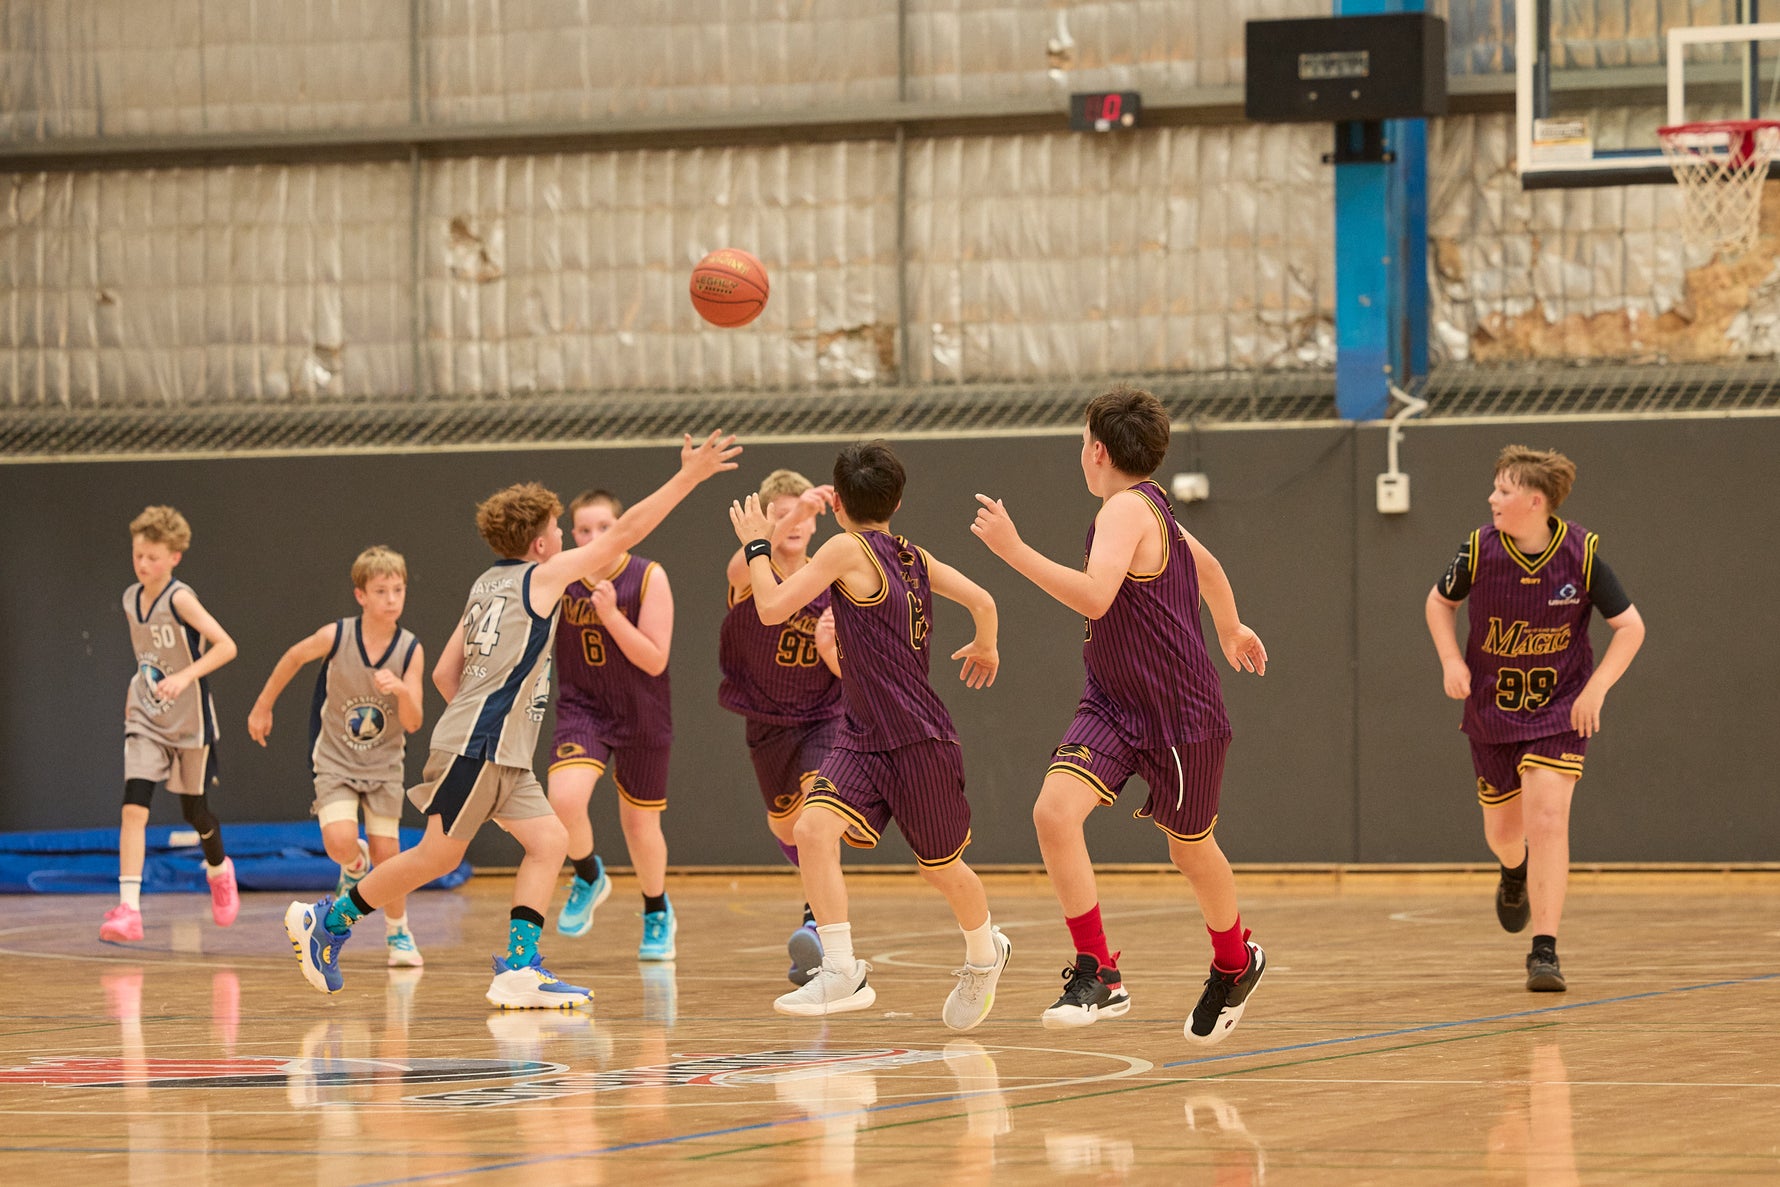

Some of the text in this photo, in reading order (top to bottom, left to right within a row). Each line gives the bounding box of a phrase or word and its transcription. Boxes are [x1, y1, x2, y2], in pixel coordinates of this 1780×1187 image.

[1102, 93, 1122, 121] 0
[150, 624, 176, 648] 50
[582, 628, 606, 666] 6
[1496, 667, 1558, 713] 99
